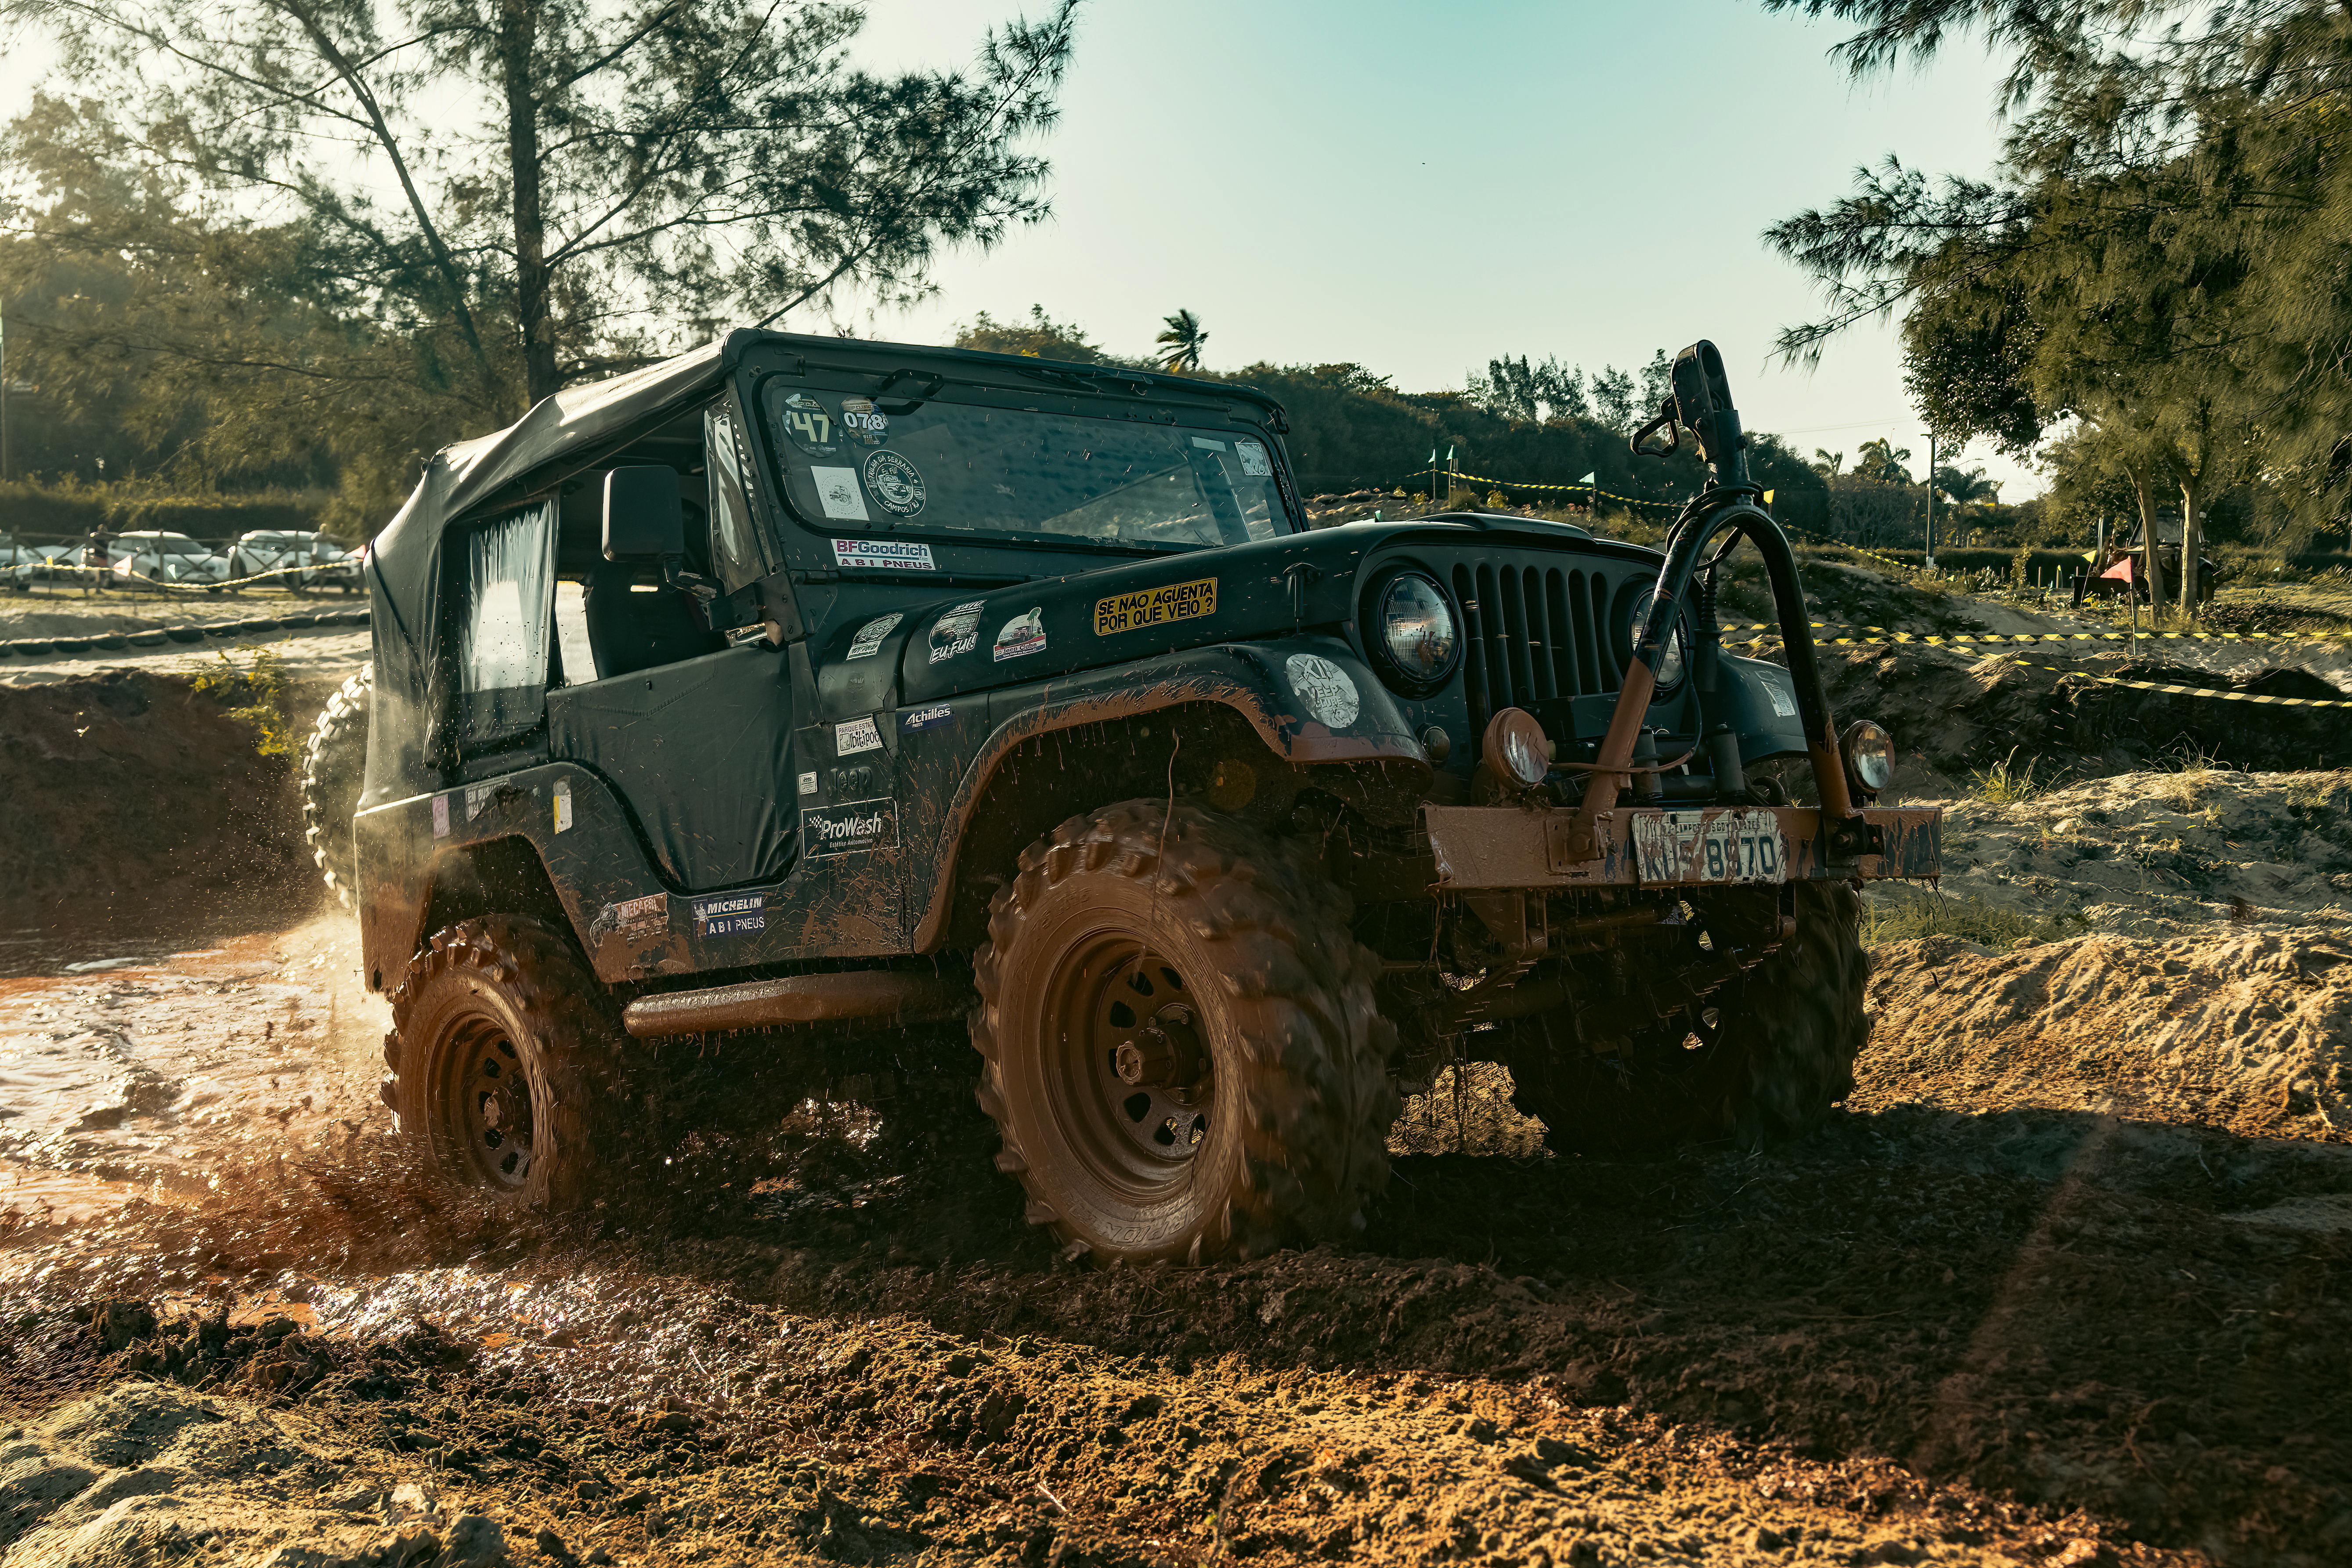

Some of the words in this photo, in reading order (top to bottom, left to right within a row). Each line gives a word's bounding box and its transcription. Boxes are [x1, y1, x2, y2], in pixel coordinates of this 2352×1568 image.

[791, 412, 829, 443] 47
[844, 412, 885, 430] 078
[888, 455, 914, 477] SERRARIA
[836, 540, 928, 556] BFGoodrich
[882, 560, 932, 569] PNEUS
[1098, 600, 1116, 616] SE
[1119, 594, 1149, 611] NÃO
[1098, 613, 1127, 633] POR
[1133, 605, 1162, 626] QUE
[1167, 599, 1200, 619] VEIO
[931, 645, 948, 662] EU
[905, 708, 950, 726] Achilles
[838, 724, 859, 734] PARQUE
[820, 811, 882, 840] ProWash
[707, 896, 762, 914] MICHELIN
[735, 917, 765, 931] PNEUS
